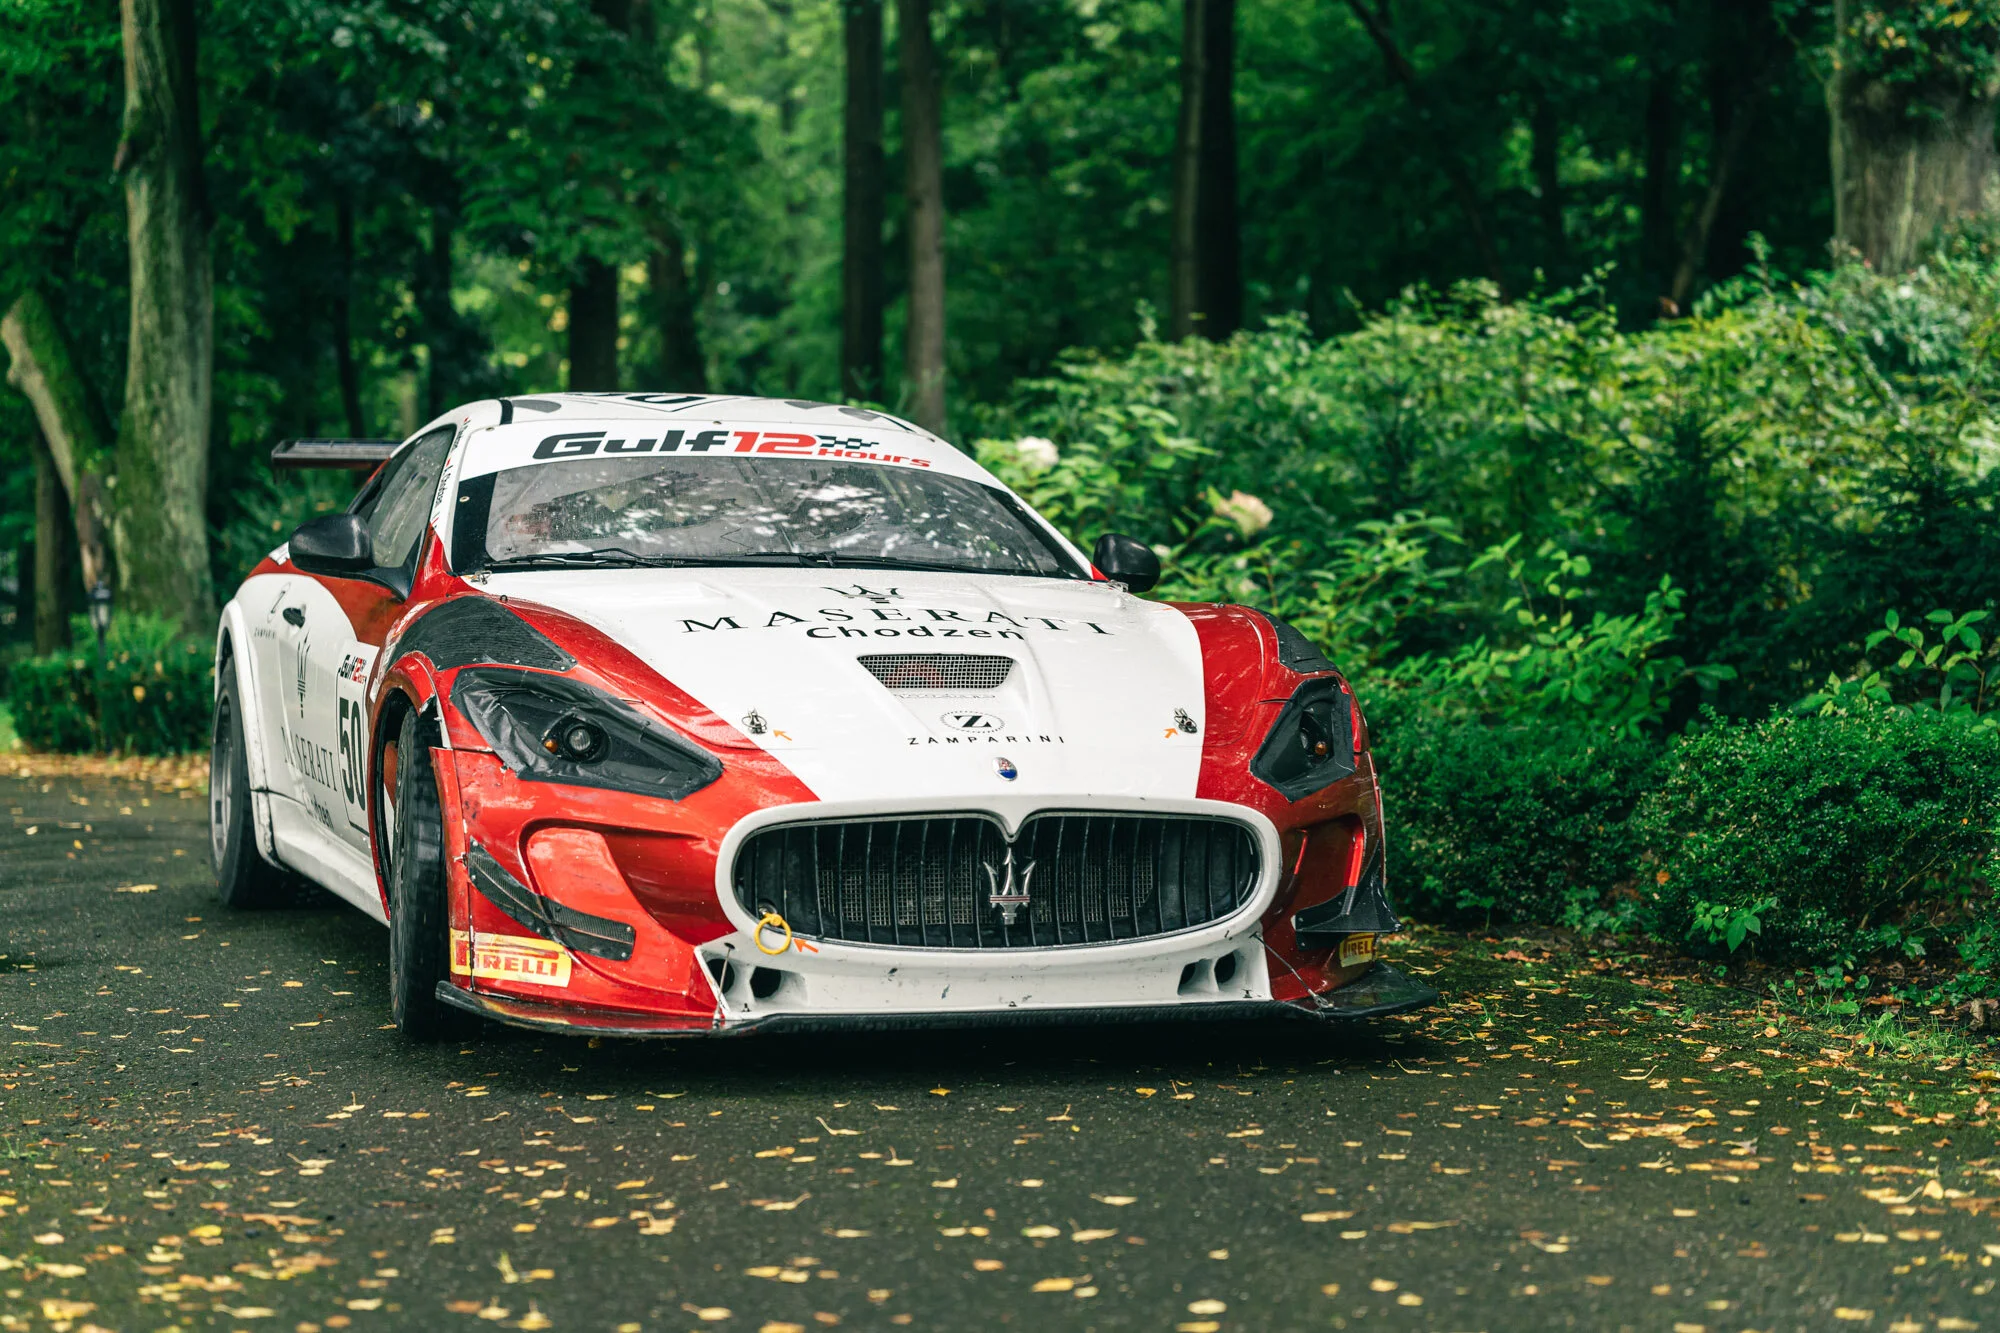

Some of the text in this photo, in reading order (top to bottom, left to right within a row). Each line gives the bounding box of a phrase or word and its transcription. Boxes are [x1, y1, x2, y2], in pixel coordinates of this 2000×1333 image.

[533, 430, 730, 459] Gulf
[733, 431, 818, 455] 12
[674, 608, 1115, 636] MASERATI
[339, 696, 366, 811] 50
[907, 735, 1065, 746] ZAMPARINI
[455, 939, 560, 977] PIRELLI
